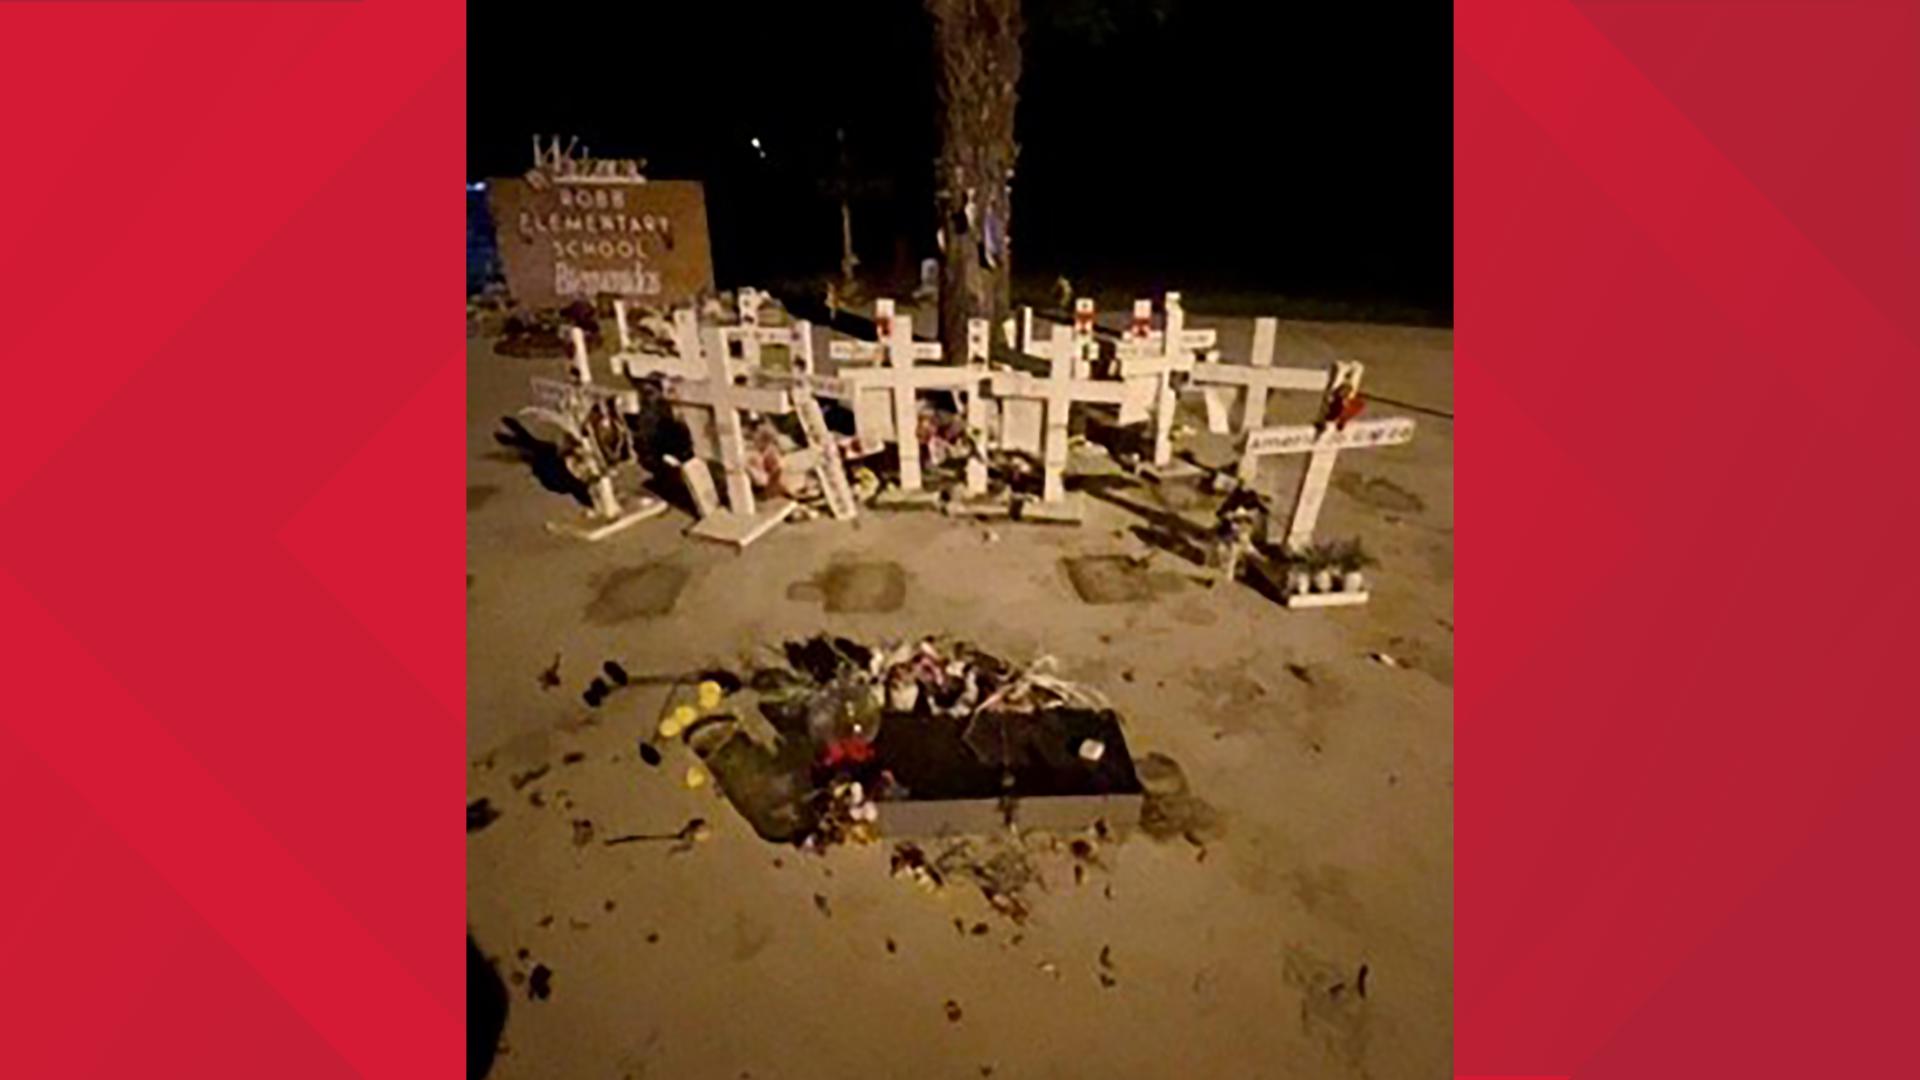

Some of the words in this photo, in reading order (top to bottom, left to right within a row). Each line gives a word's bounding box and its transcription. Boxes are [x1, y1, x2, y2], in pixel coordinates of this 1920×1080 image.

[559, 189, 626, 209] ROBB
[518, 212, 670, 233] ELEMENTARY
[552, 239, 649, 258] SCHOOL
